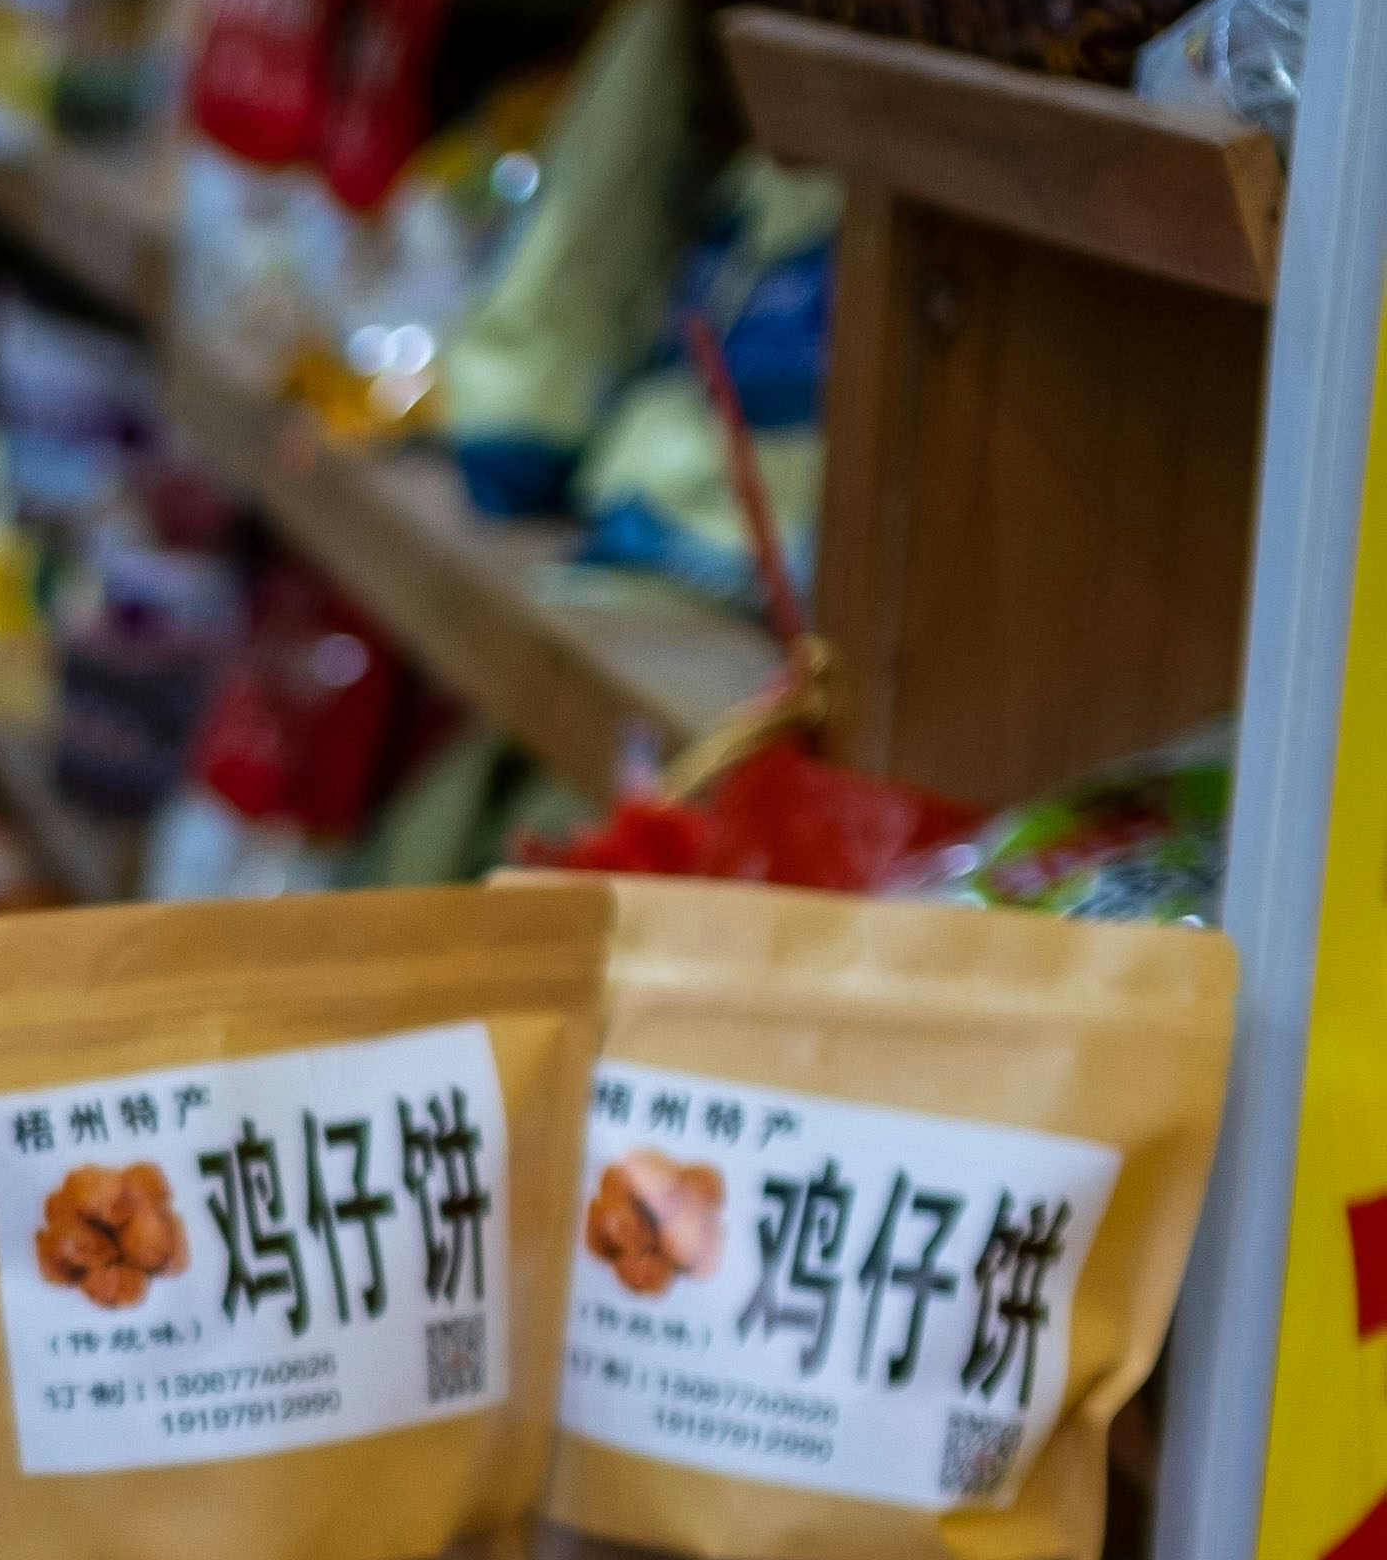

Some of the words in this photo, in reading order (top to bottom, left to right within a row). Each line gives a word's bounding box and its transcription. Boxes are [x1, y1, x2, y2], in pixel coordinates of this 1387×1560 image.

[12, 1083, 211, 1156] 梧州特产
[196, 1085, 491, 1338] 鸡仔饼
[735, 1153, 1073, 1412] 鸡仔饼
